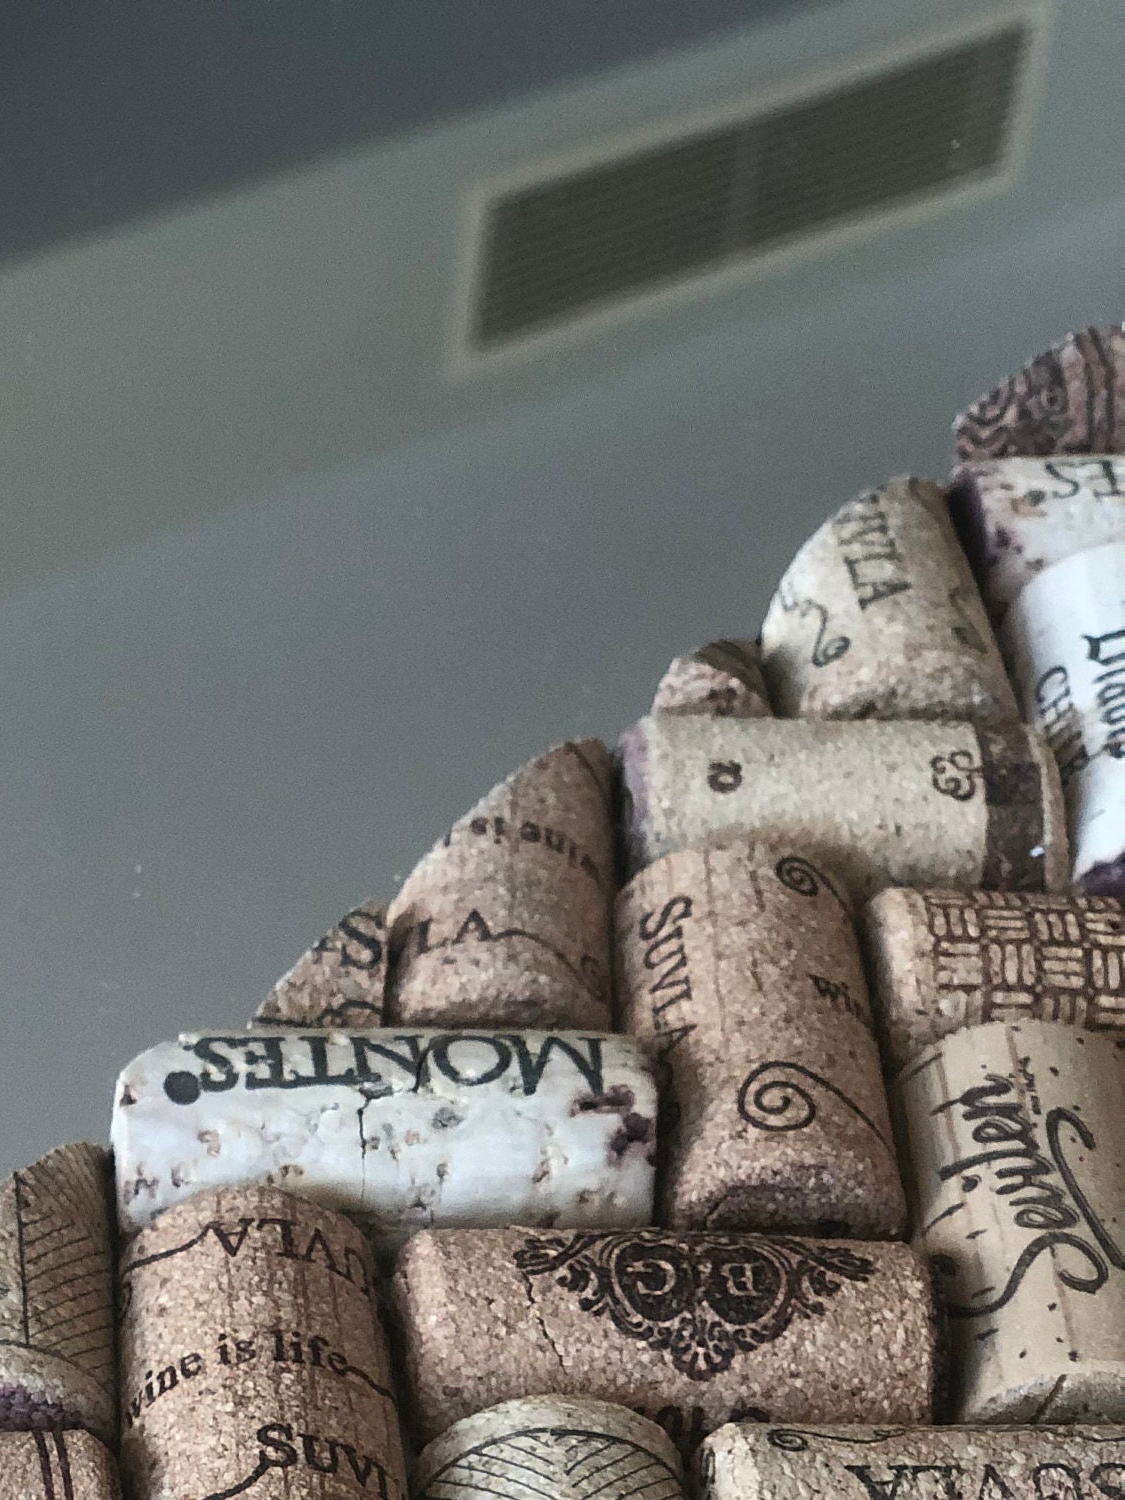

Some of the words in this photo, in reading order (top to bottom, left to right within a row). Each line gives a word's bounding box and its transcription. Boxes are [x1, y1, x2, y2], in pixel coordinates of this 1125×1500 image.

[185, 1034, 606, 1097] MONTES
[216, 1333, 256, 1365] is
[266, 1329, 348, 1377] life
